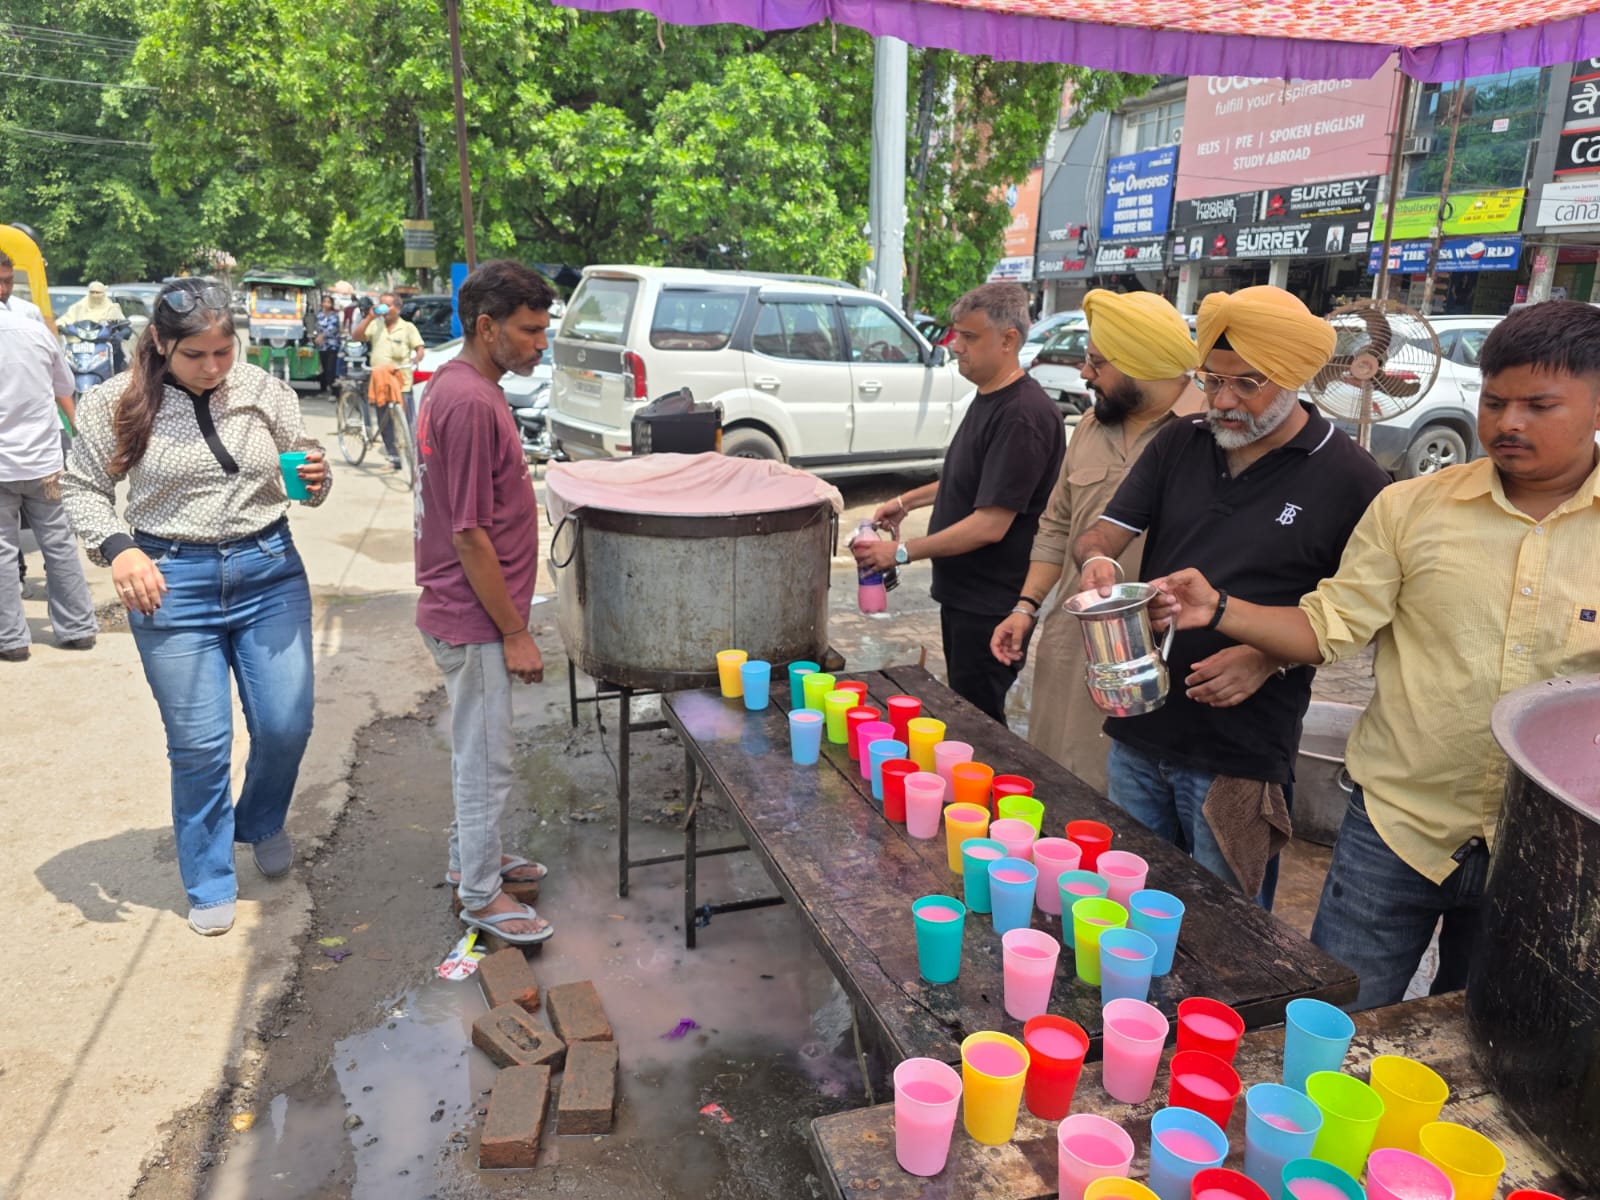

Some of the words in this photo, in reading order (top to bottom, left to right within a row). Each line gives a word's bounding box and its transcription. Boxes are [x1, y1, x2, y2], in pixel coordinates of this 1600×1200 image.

[1215, 96, 1244, 116] fulfill
[1247, 92, 1275, 112] your
[1278, 80, 1353, 103] aspirations
[1197, 140, 1220, 156] IELTS
[1235, 134, 1254, 150] PTE
[1269, 123, 1312, 144] SPOKEN
[1314, 114, 1365, 136] ENGLISH
[1233, 154, 1265, 170] STUDY
[1266, 146, 1311, 166] ABROAD
[1291, 180, 1368, 202] SURREY
[1197, 203, 1237, 223] heaven
[1201, 199, 1234, 210] mobile
[1291, 200, 1326, 210] IMMIGRATION
[1327, 196, 1366, 206] CONSULTANCY
[1555, 203, 1600, 221] cana
[1236, 230, 1310, 251] SURREY
[1402, 250, 1425, 261] THE
